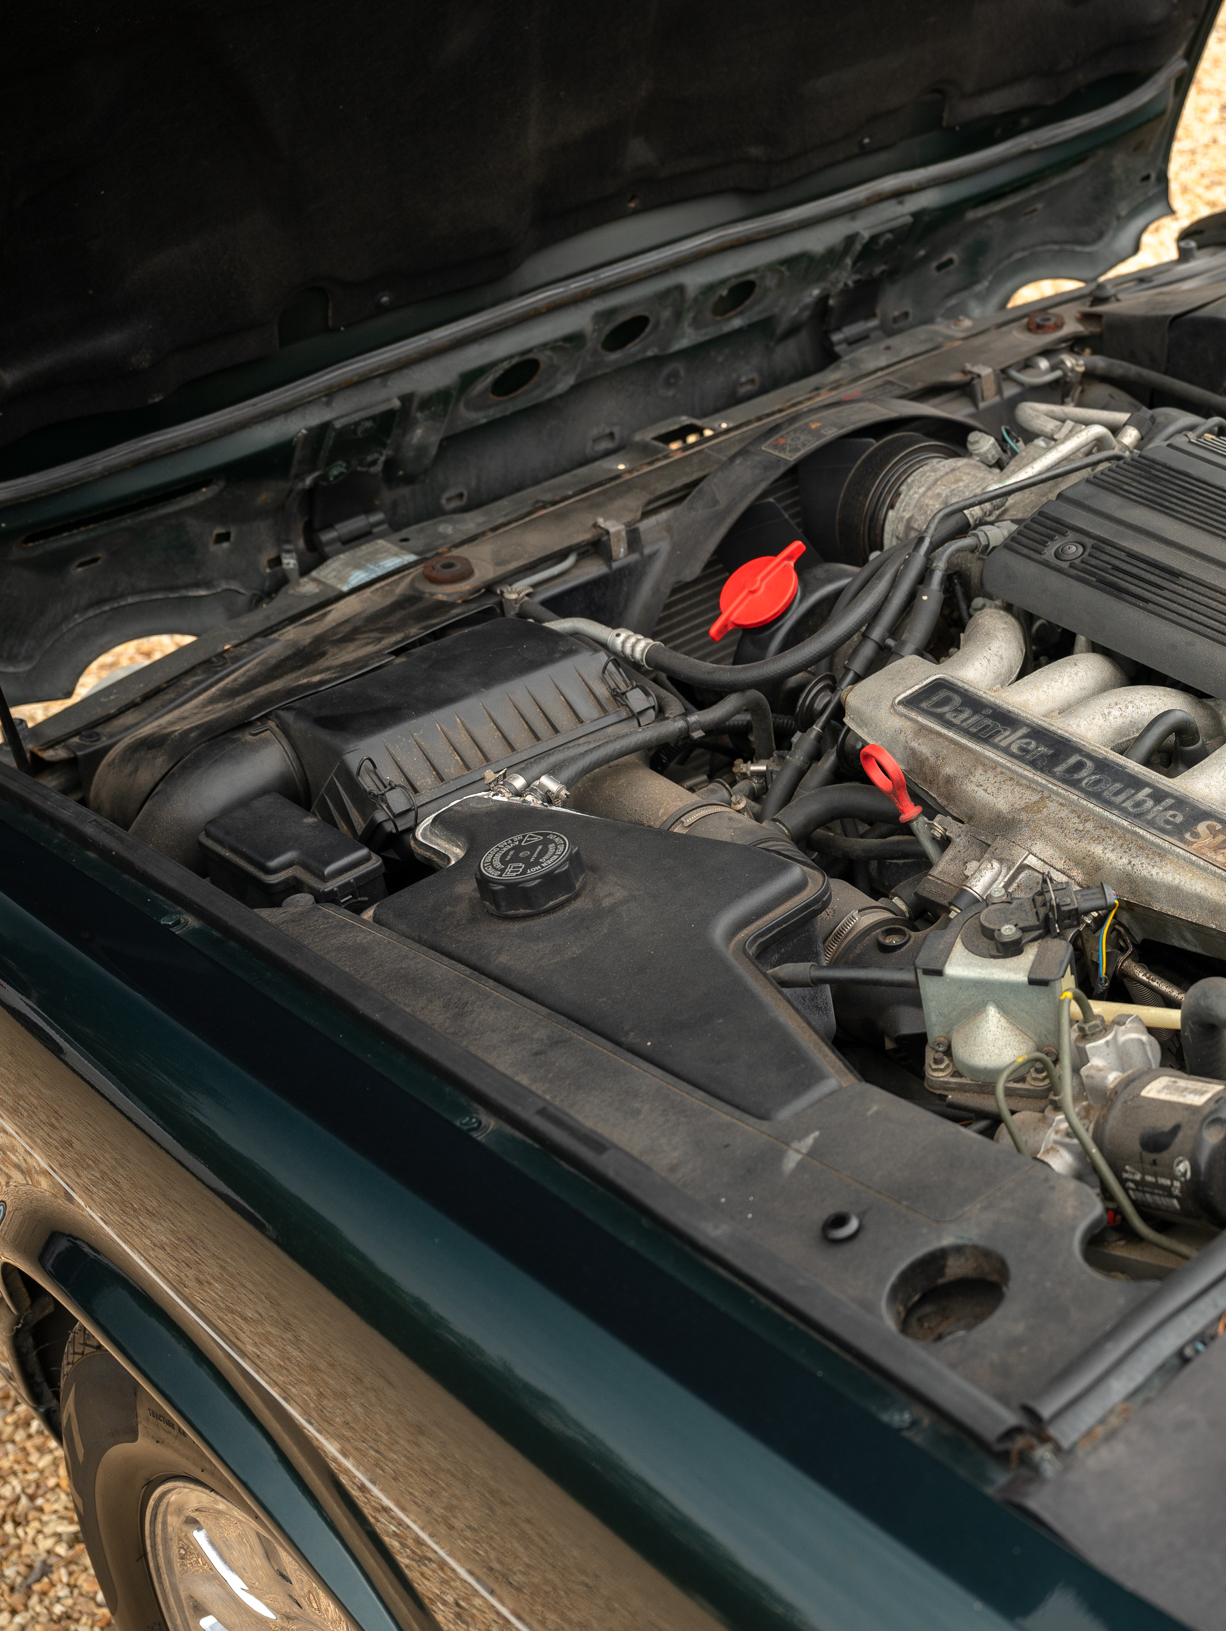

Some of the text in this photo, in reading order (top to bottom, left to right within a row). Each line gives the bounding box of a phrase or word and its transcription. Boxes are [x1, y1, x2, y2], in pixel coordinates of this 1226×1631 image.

[919, 688, 1055, 763] Daimler
[1053, 753, 1184, 828] Double
[526, 866, 542, 874] HOT
